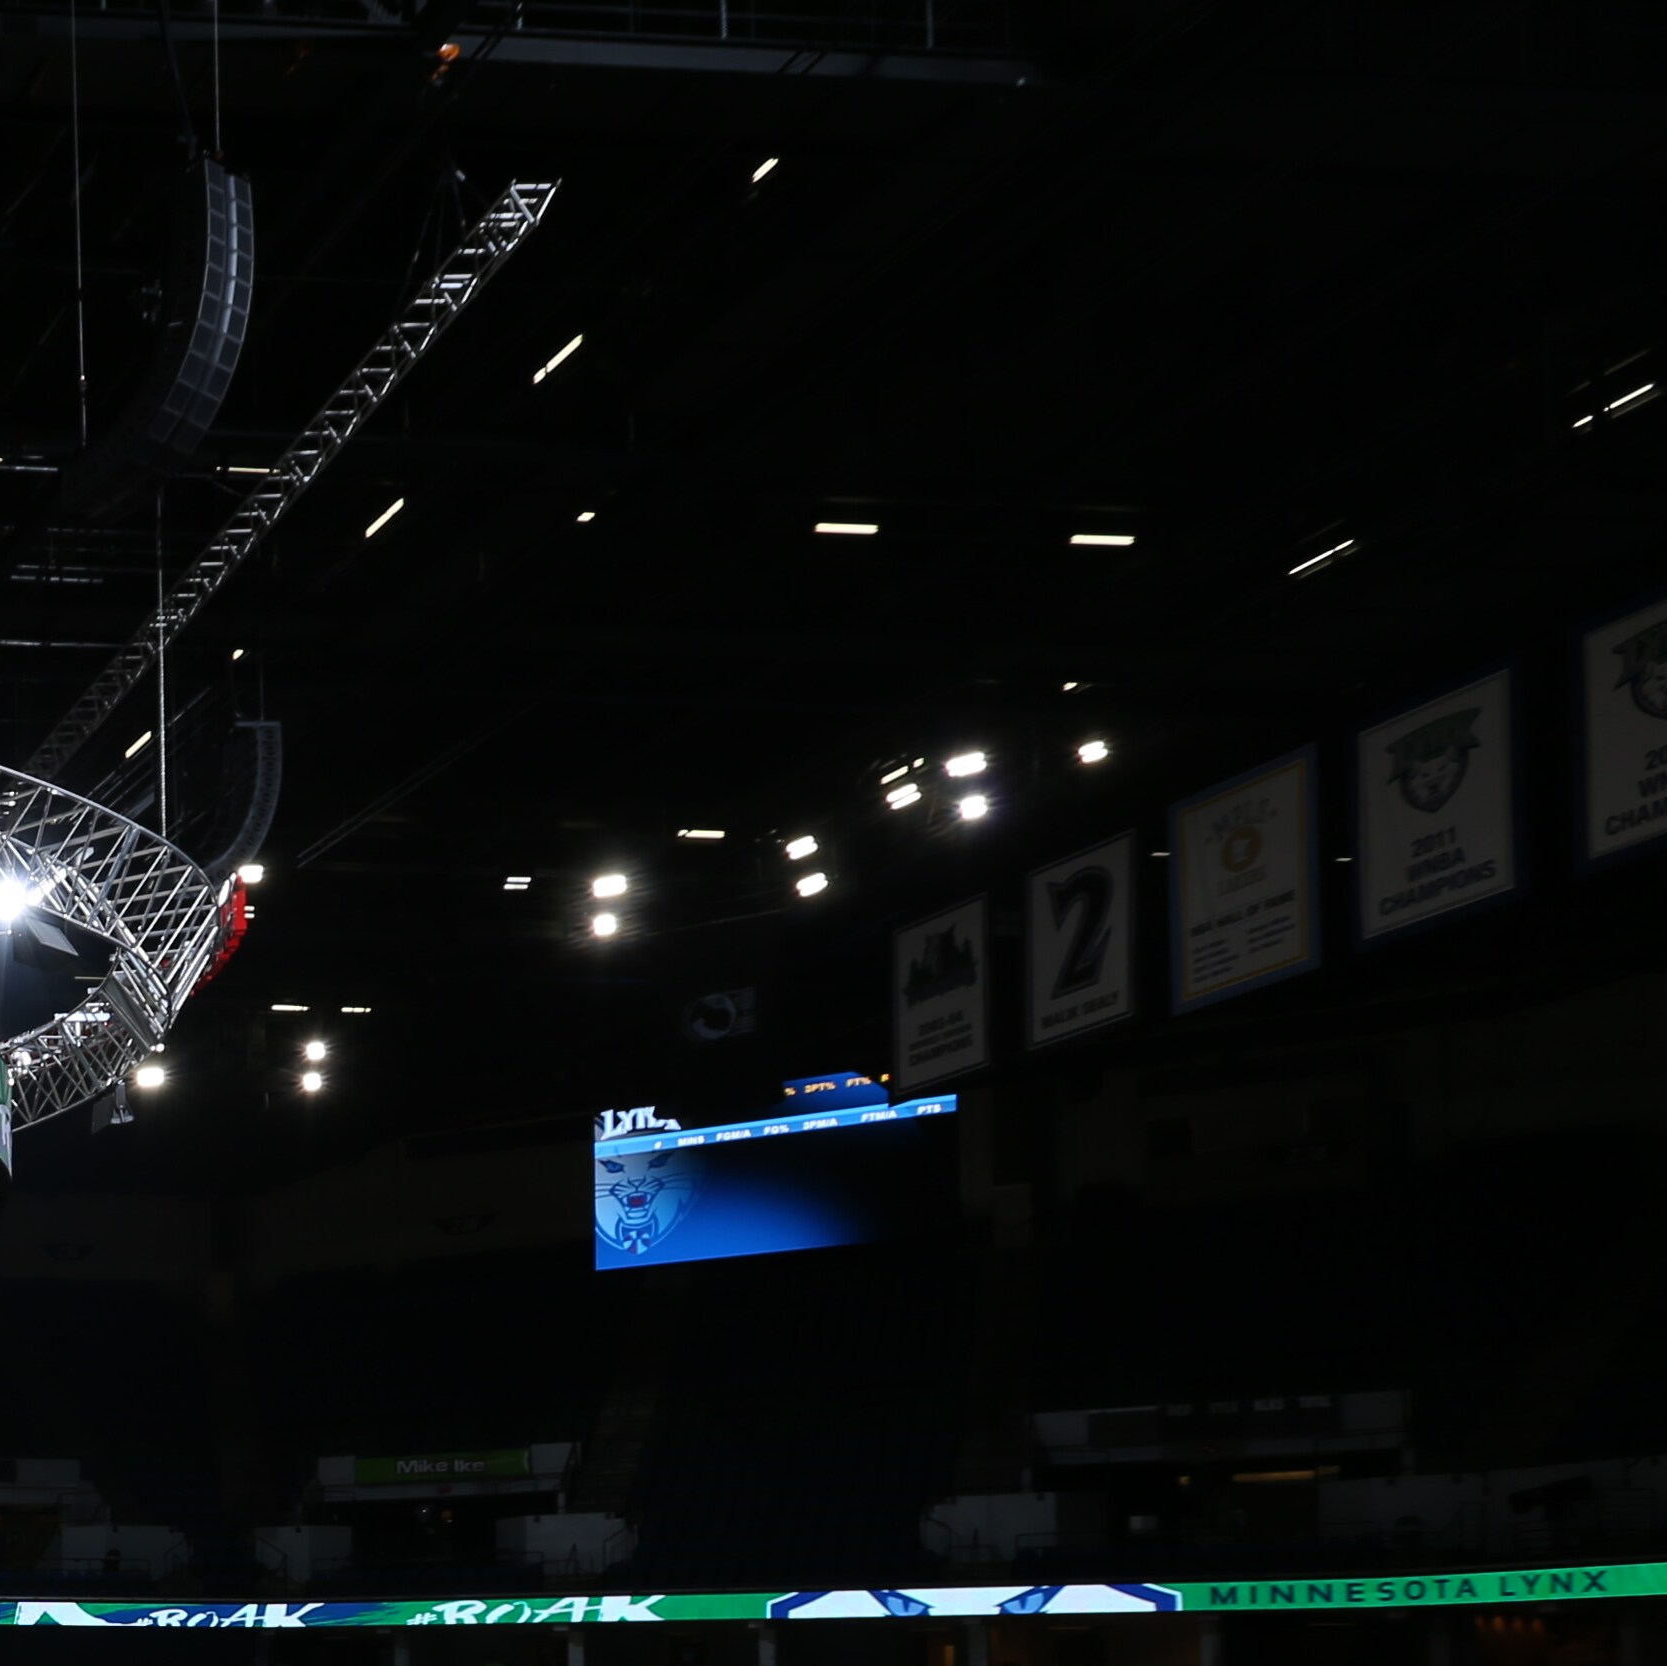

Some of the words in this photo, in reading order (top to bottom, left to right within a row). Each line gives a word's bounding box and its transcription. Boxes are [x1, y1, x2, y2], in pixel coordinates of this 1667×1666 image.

[1411, 826, 1457, 858] 2011
[1407, 847, 1466, 882] WNBA
[1379, 859, 1498, 916] CHAMPIONS
[1047, 865, 1114, 1000] 2
[916, 1102, 943, 1115] PTS
[395, 1458, 448, 1475] Mike
[1210, 1578, 1478, 1606] MINNESOTA
[1499, 1570, 1608, 1597] LYNX
